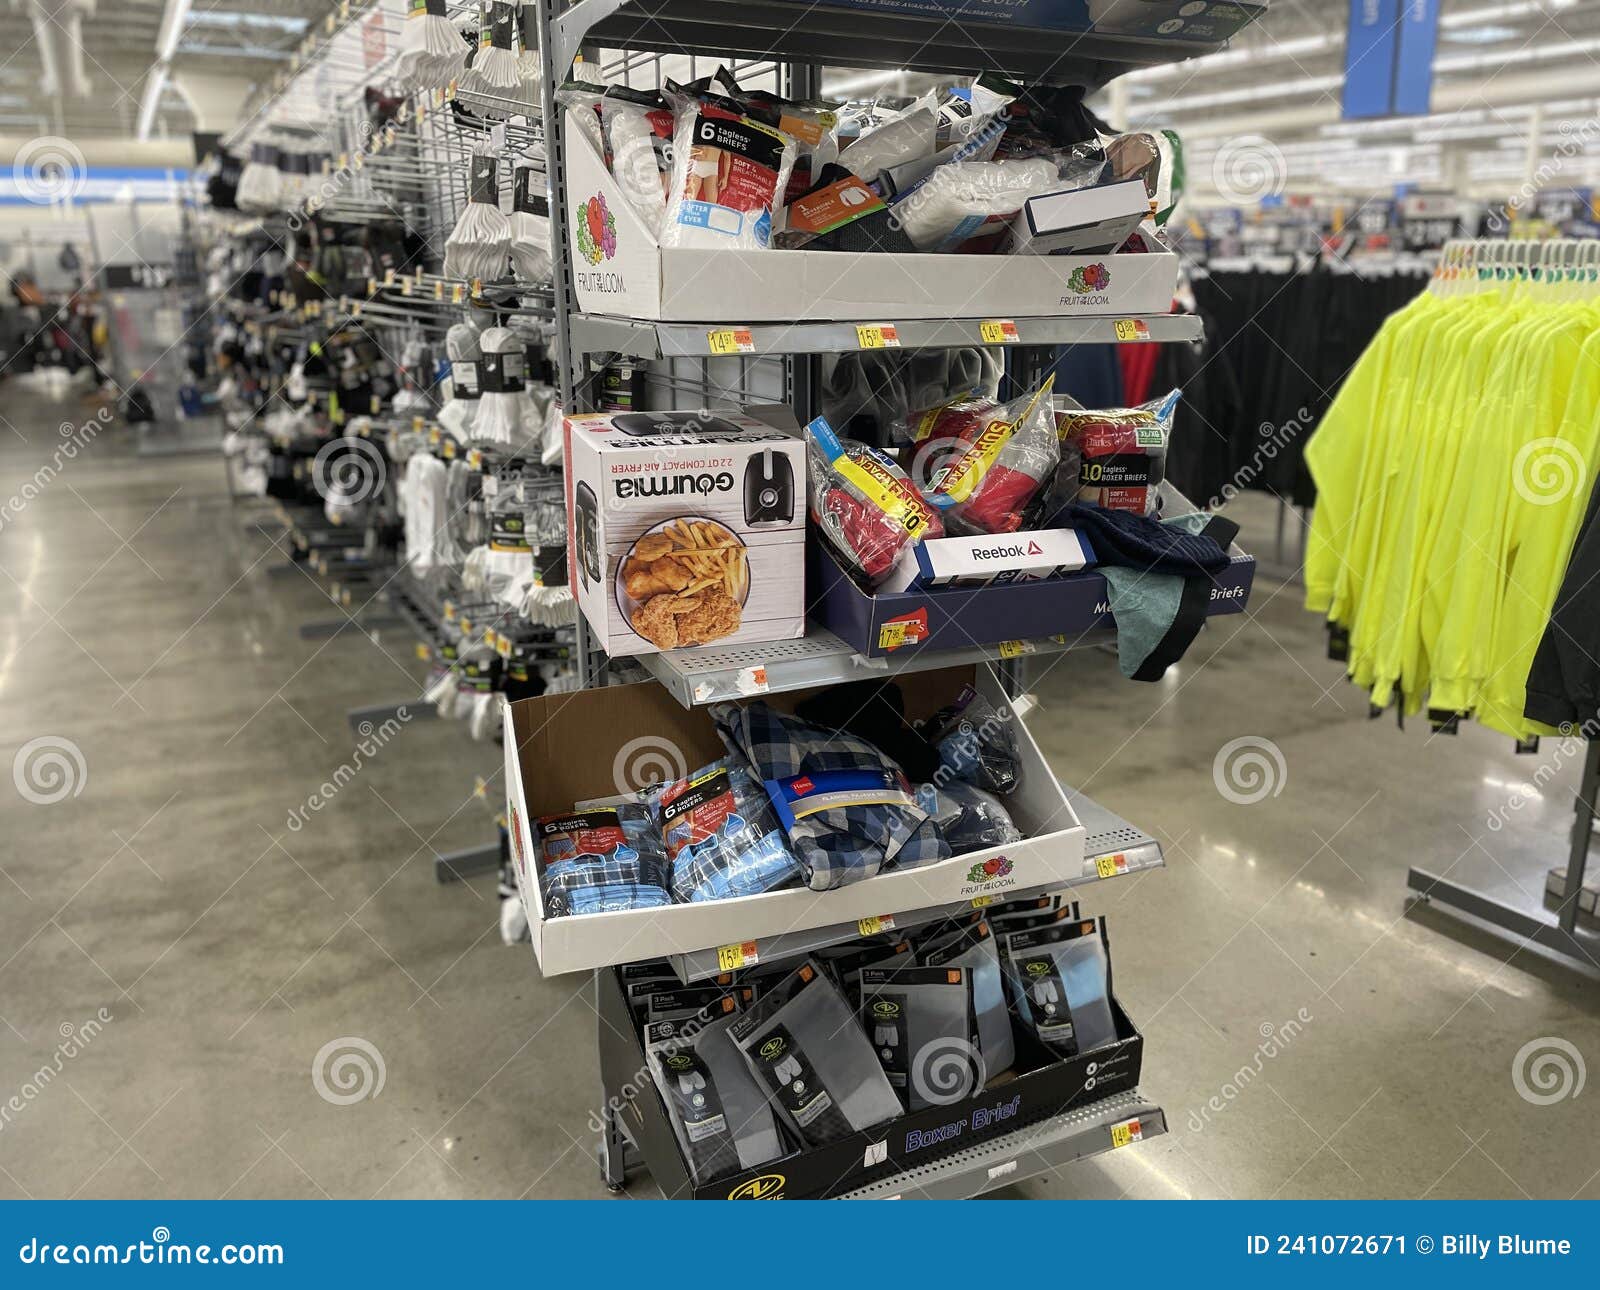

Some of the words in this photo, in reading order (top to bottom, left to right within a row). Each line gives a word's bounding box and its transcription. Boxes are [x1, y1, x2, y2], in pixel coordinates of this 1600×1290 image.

[700, 122, 716, 140] 6
[718, 127, 749, 143] tagless
[717, 135, 747, 151] BRIEFS
[733, 158, 751, 169] SOFT
[682, 203, 708, 213] OFTER
[684, 215, 702, 223] EVER
[578, 272, 596, 292] FRUIT
[603, 273, 625, 293] LOOM
[1059, 296, 1080, 306] FRUIT
[1086, 295, 1109, 305] LOOM
[611, 464, 642, 473] FRYER
[643, 462, 660, 472] AIR
[662, 460, 705, 471] COMPACT
[707, 458, 719, 468] QT
[1081, 463, 1103, 481] 10
[1103, 465, 1125, 474] tagless
[1101, 473, 1123, 481] BOXER
[1124, 473, 1147, 481] BRIEFS
[972, 544, 1026, 561] Reebok
[1210, 585, 1244, 600] Briefs
[665, 804, 676, 819] 6
[676, 792, 702, 807] tagless
[677, 796, 704, 813] BOXERS
[545, 823, 557, 833] 6
[559, 822, 589, 832] BOXERS
[960, 884, 984, 895] FRUIT
[991, 878, 1016, 889] LOOM
[905, 1119, 968, 1153] Boxer
[971, 1094, 1021, 1131] Brief
